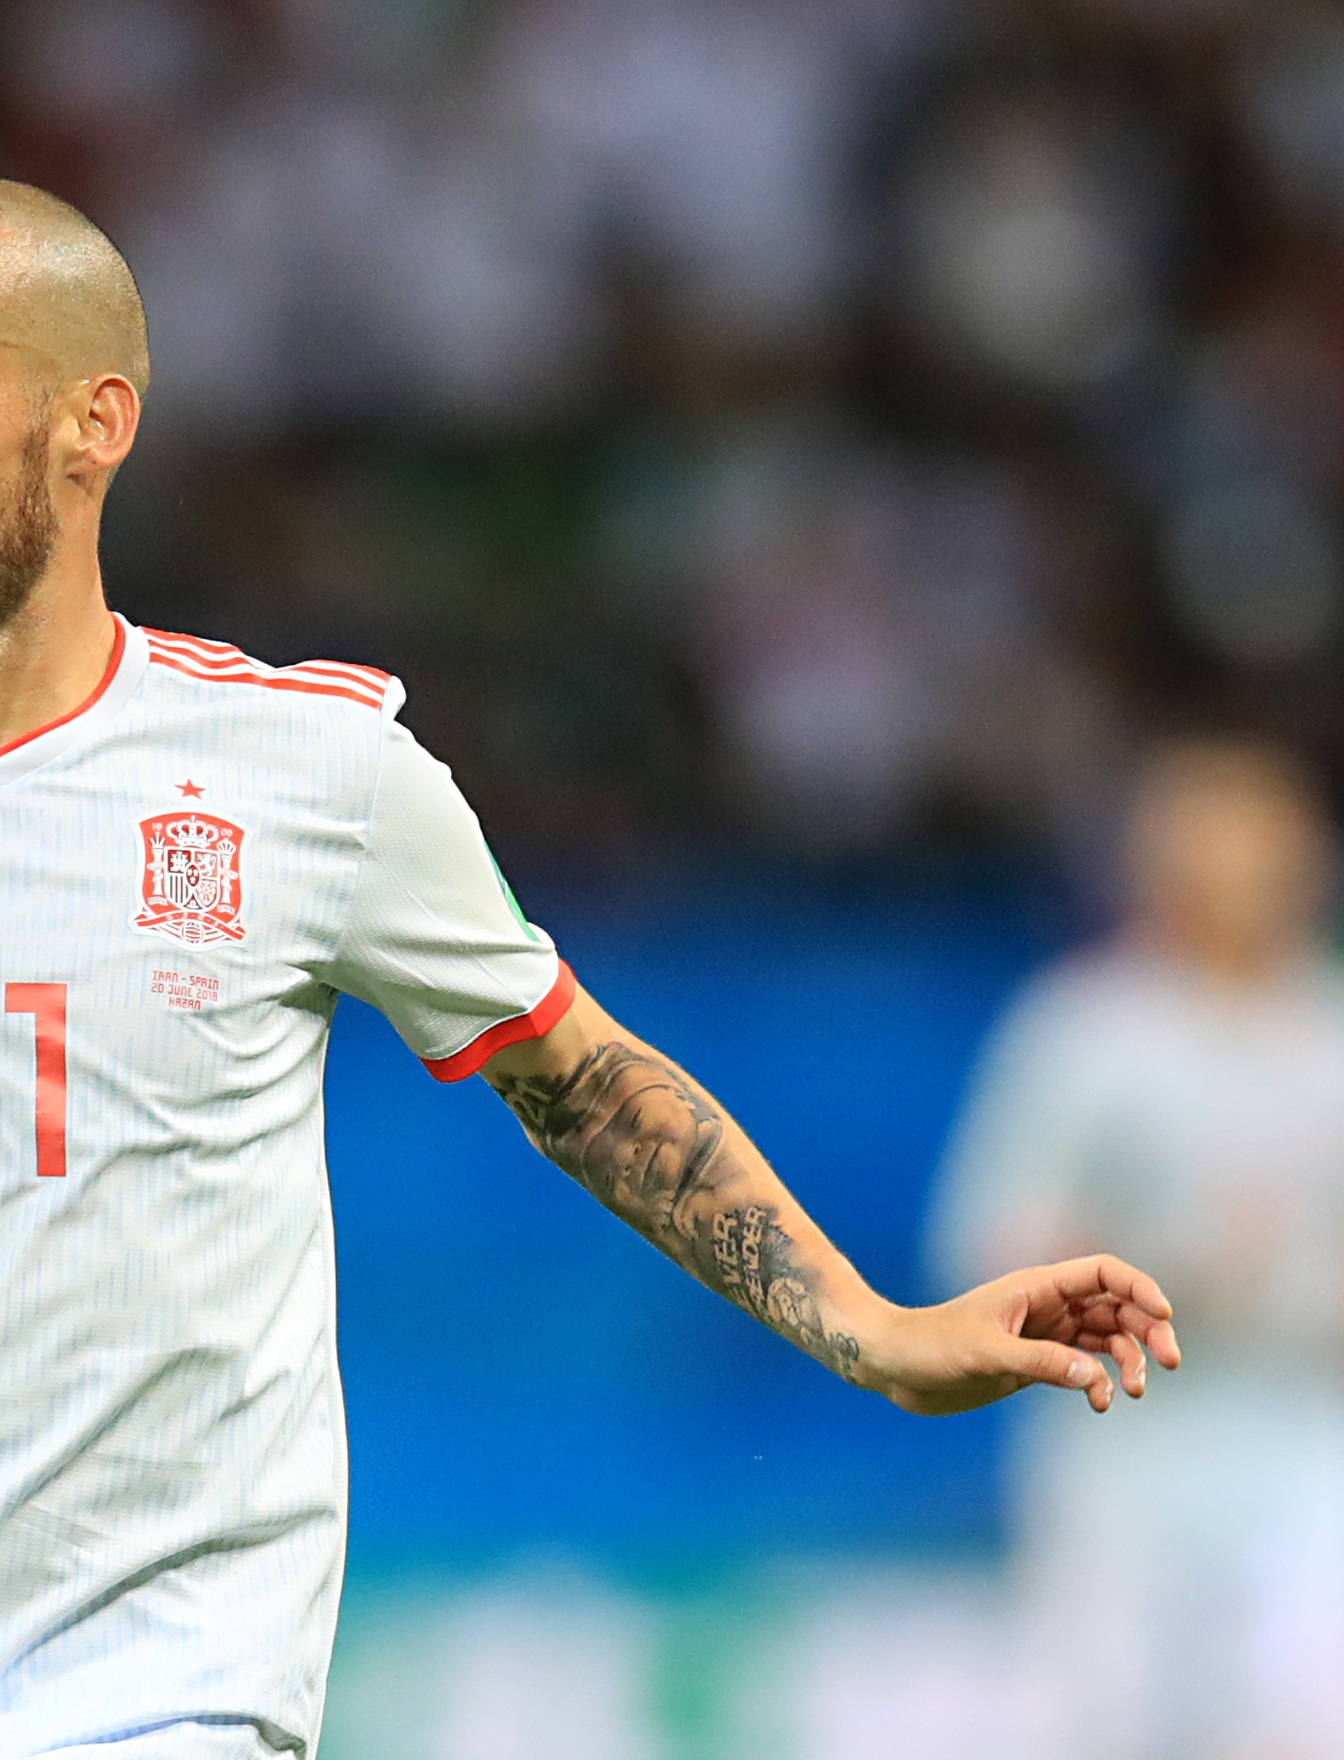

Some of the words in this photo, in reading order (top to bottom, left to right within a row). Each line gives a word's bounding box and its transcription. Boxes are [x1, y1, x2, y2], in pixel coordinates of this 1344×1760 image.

[152, 970, 179, 983] IRAN
[189, 975, 219, 990] SPAIN
[151, 982, 164, 994] 20
[167, 984, 193, 998] JUNE
[196, 988, 218, 1002] 2018
[168, 997, 201, 1010] KAZAN
